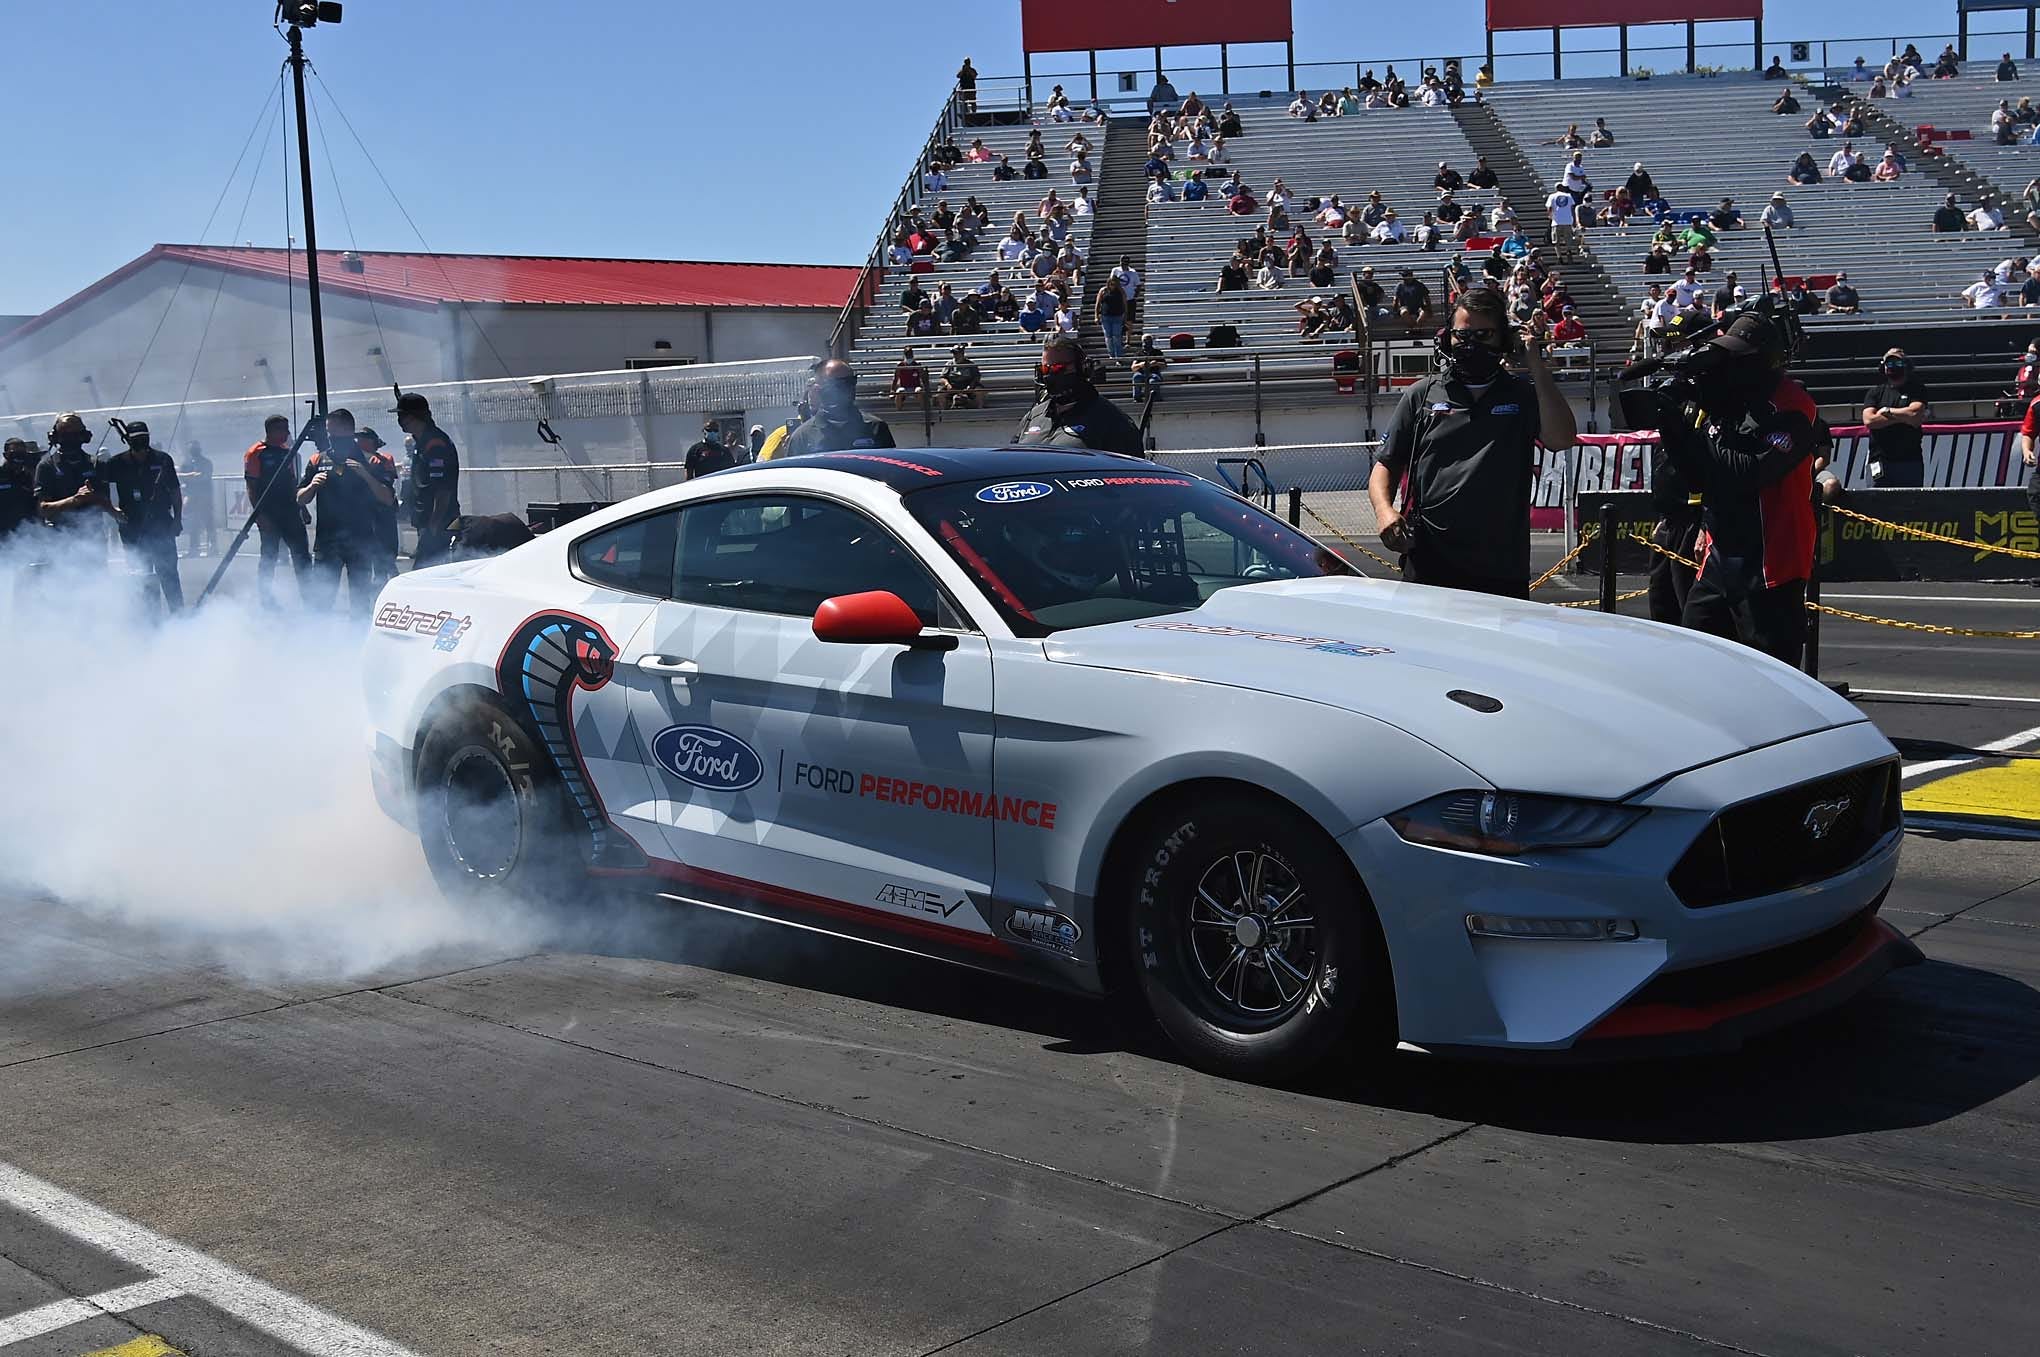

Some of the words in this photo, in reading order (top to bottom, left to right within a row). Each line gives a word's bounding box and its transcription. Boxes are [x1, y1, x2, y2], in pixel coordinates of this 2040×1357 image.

[1793, 44, 1807, 61] 3
[1122, 74, 1133, 91] 1
[1068, 478, 1104, 488] FORD
[1104, 477, 1193, 487] PERFORMANCE
[991, 484, 1042, 501] Ford
[674, 733, 740, 783] Ford
[795, 763, 854, 795] FORD
[859, 773, 1057, 830] PERFORMANCE
